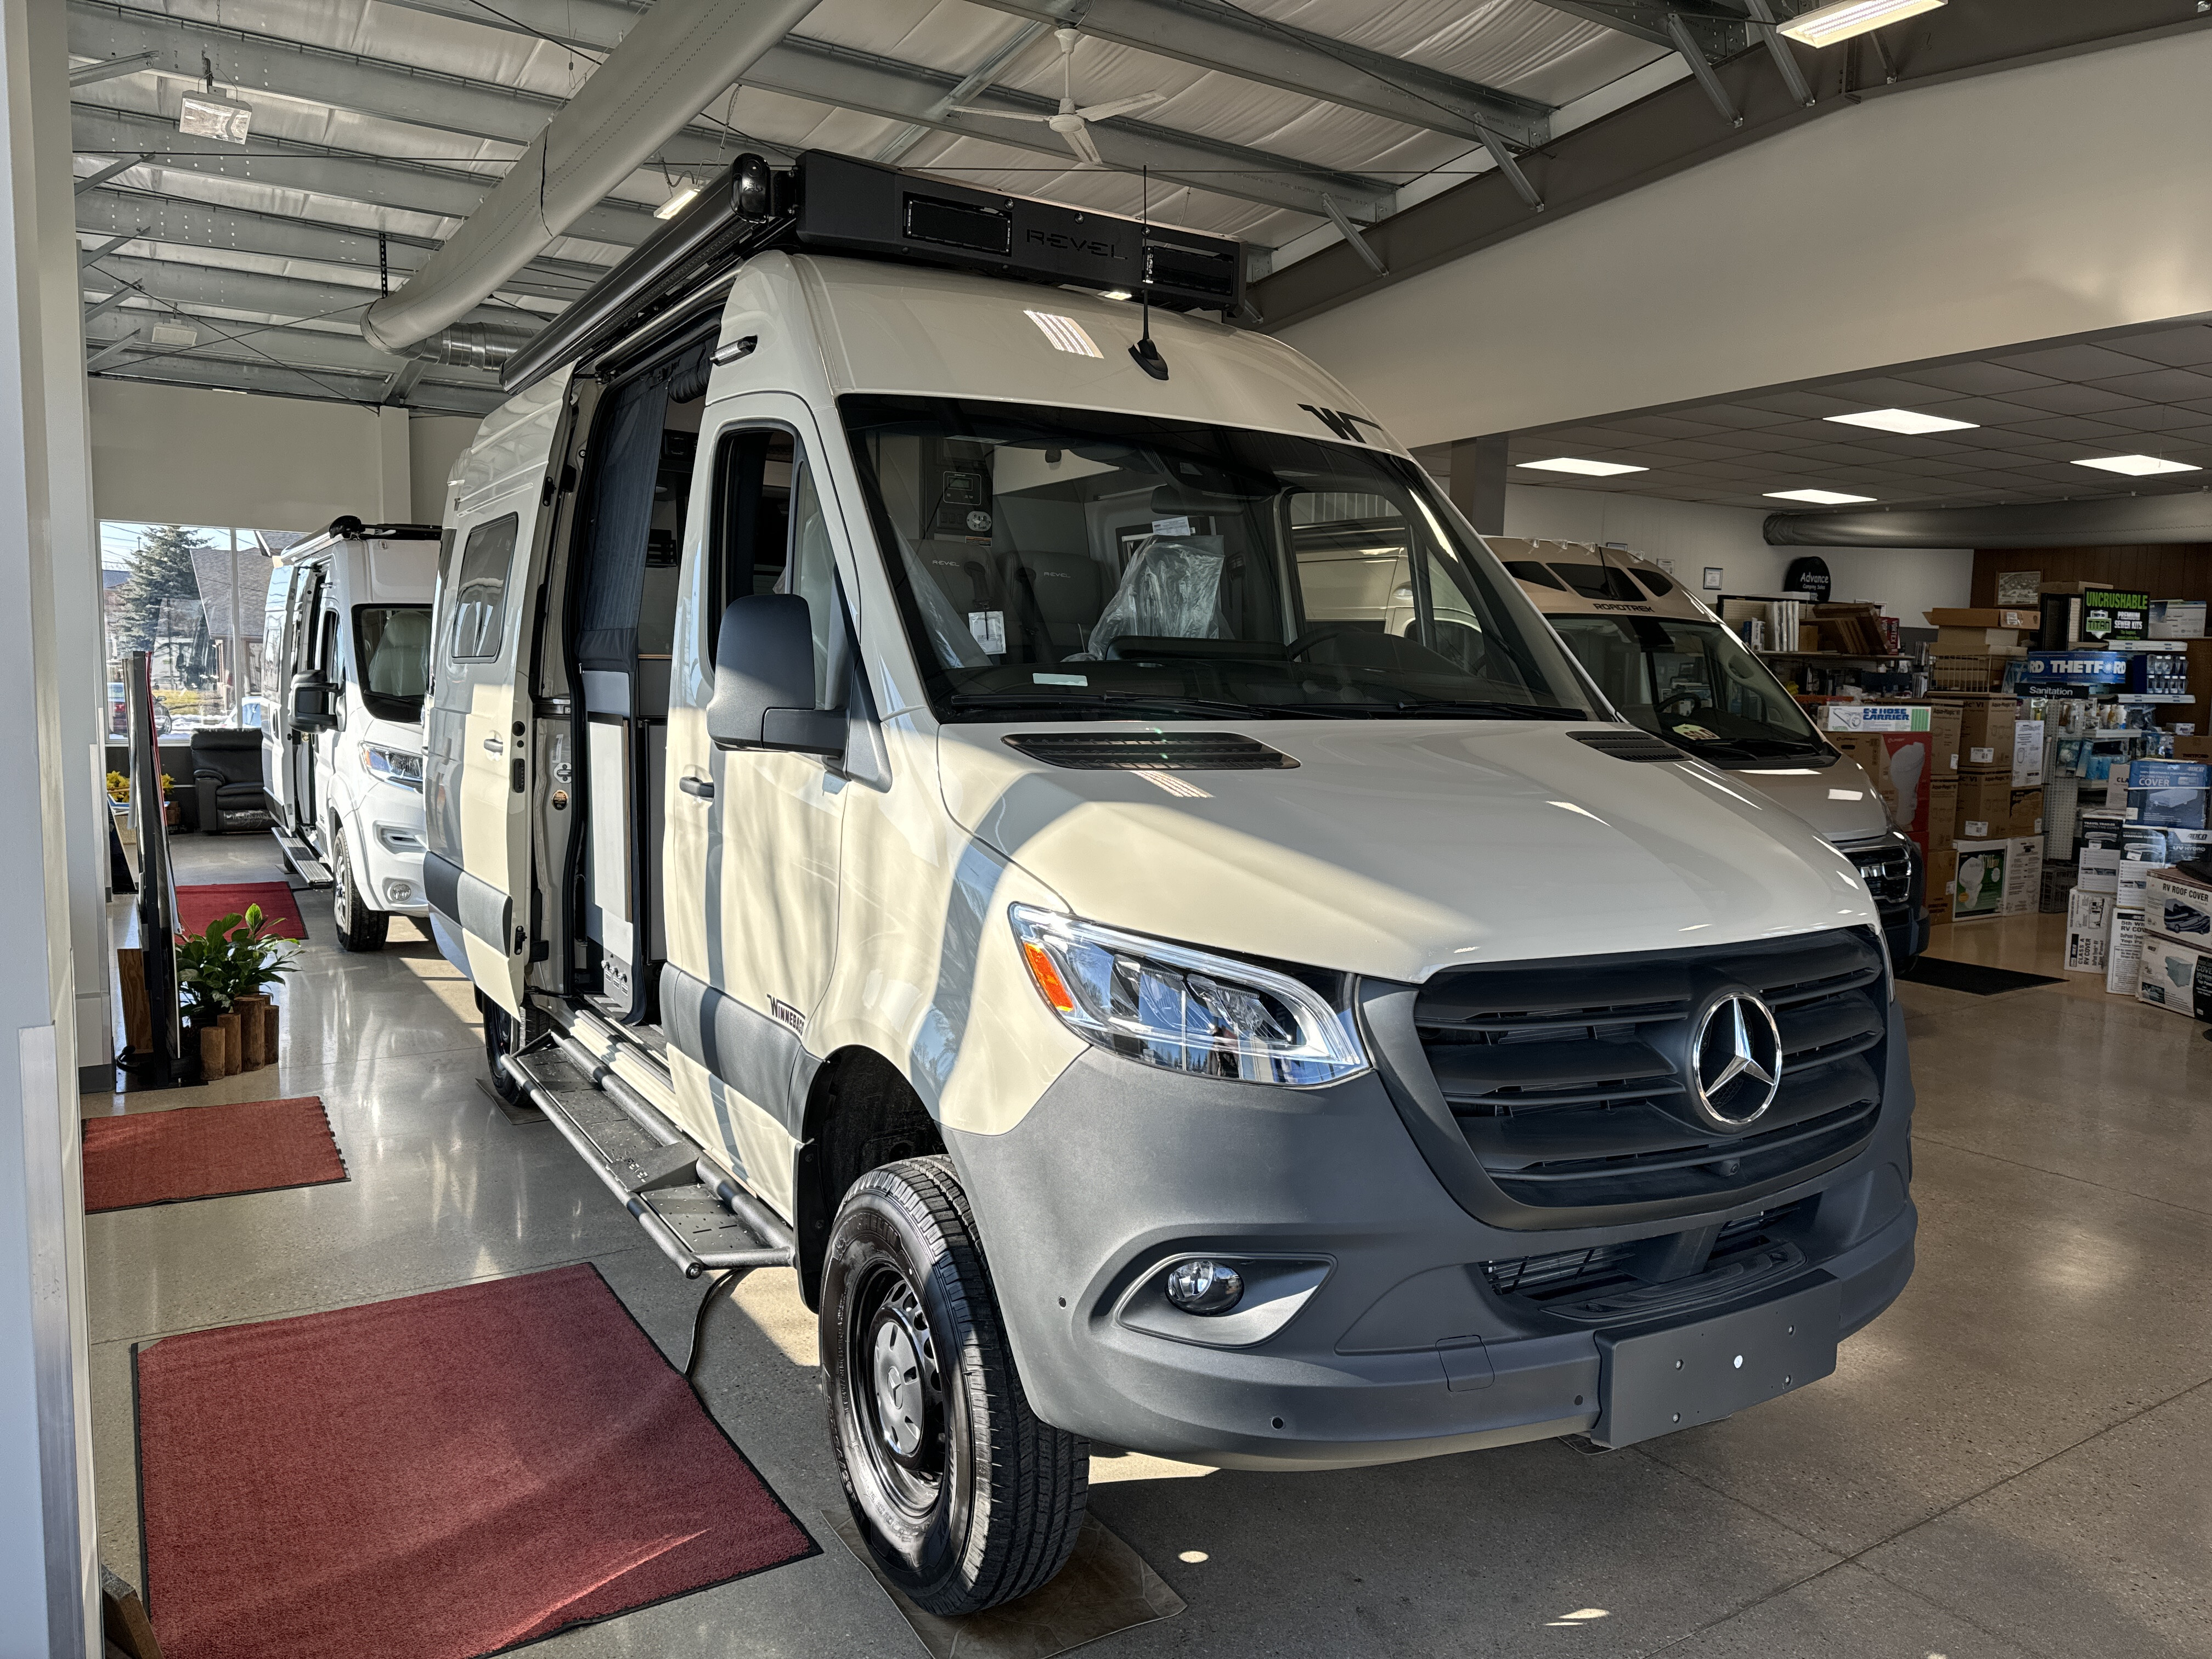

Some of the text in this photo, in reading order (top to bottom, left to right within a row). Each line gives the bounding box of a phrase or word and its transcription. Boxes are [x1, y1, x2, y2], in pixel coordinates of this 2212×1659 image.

[1026, 229, 1128, 260] REVEL
[1800, 572, 1829, 584] Advance
[2086, 591, 2148, 610] UNCRUSHABLE
[1593, 603, 1656, 613] ROADTREK
[2117, 611, 2141, 620] PREMIUM
[2088, 620, 2110, 630] TITAN
[2050, 660, 2126, 674] THETFORD
[2029, 686, 2073, 696] Sanitation
[1683, 729, 1717, 740] SOLD
[2138, 778, 2170, 787] COVER
[2163, 883, 2209, 902] RV ROOF COVER
[766, 993, 806, 1036] WINNEBAGO
